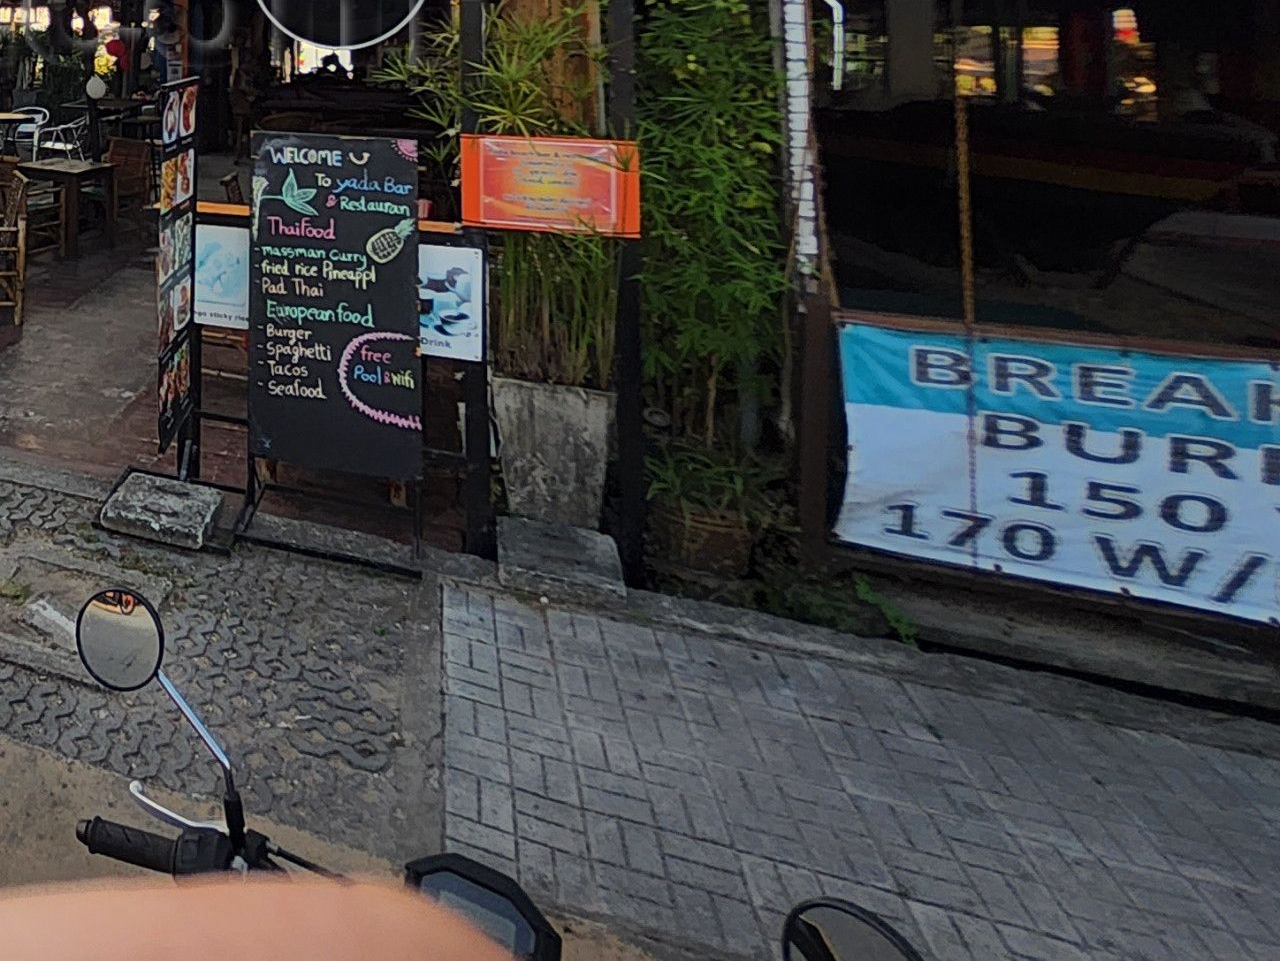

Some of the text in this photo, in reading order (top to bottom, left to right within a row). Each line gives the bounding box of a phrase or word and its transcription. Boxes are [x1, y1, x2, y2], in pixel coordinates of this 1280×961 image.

[271, 147, 342, 167] WELCOME
[315, 173, 332, 187] To
[383, 176, 413, 195] Bar
[261, 259, 290, 275] fried
[295, 262, 317, 276] rice
[262, 277, 324, 297] Pad Thai
[266, 324, 312, 345] Burger
[266, 341, 332, 364] Spaghetti
[361, 345, 391, 364] free
[267, 360, 308, 377] Tacos
[354, 365, 381, 385] Pool
[268, 378, 327, 399] Seafood
[983, 413, 1280, 486] BUR
[1009, 472, 1228, 533] 150
[883, 504, 1055, 562] 170
